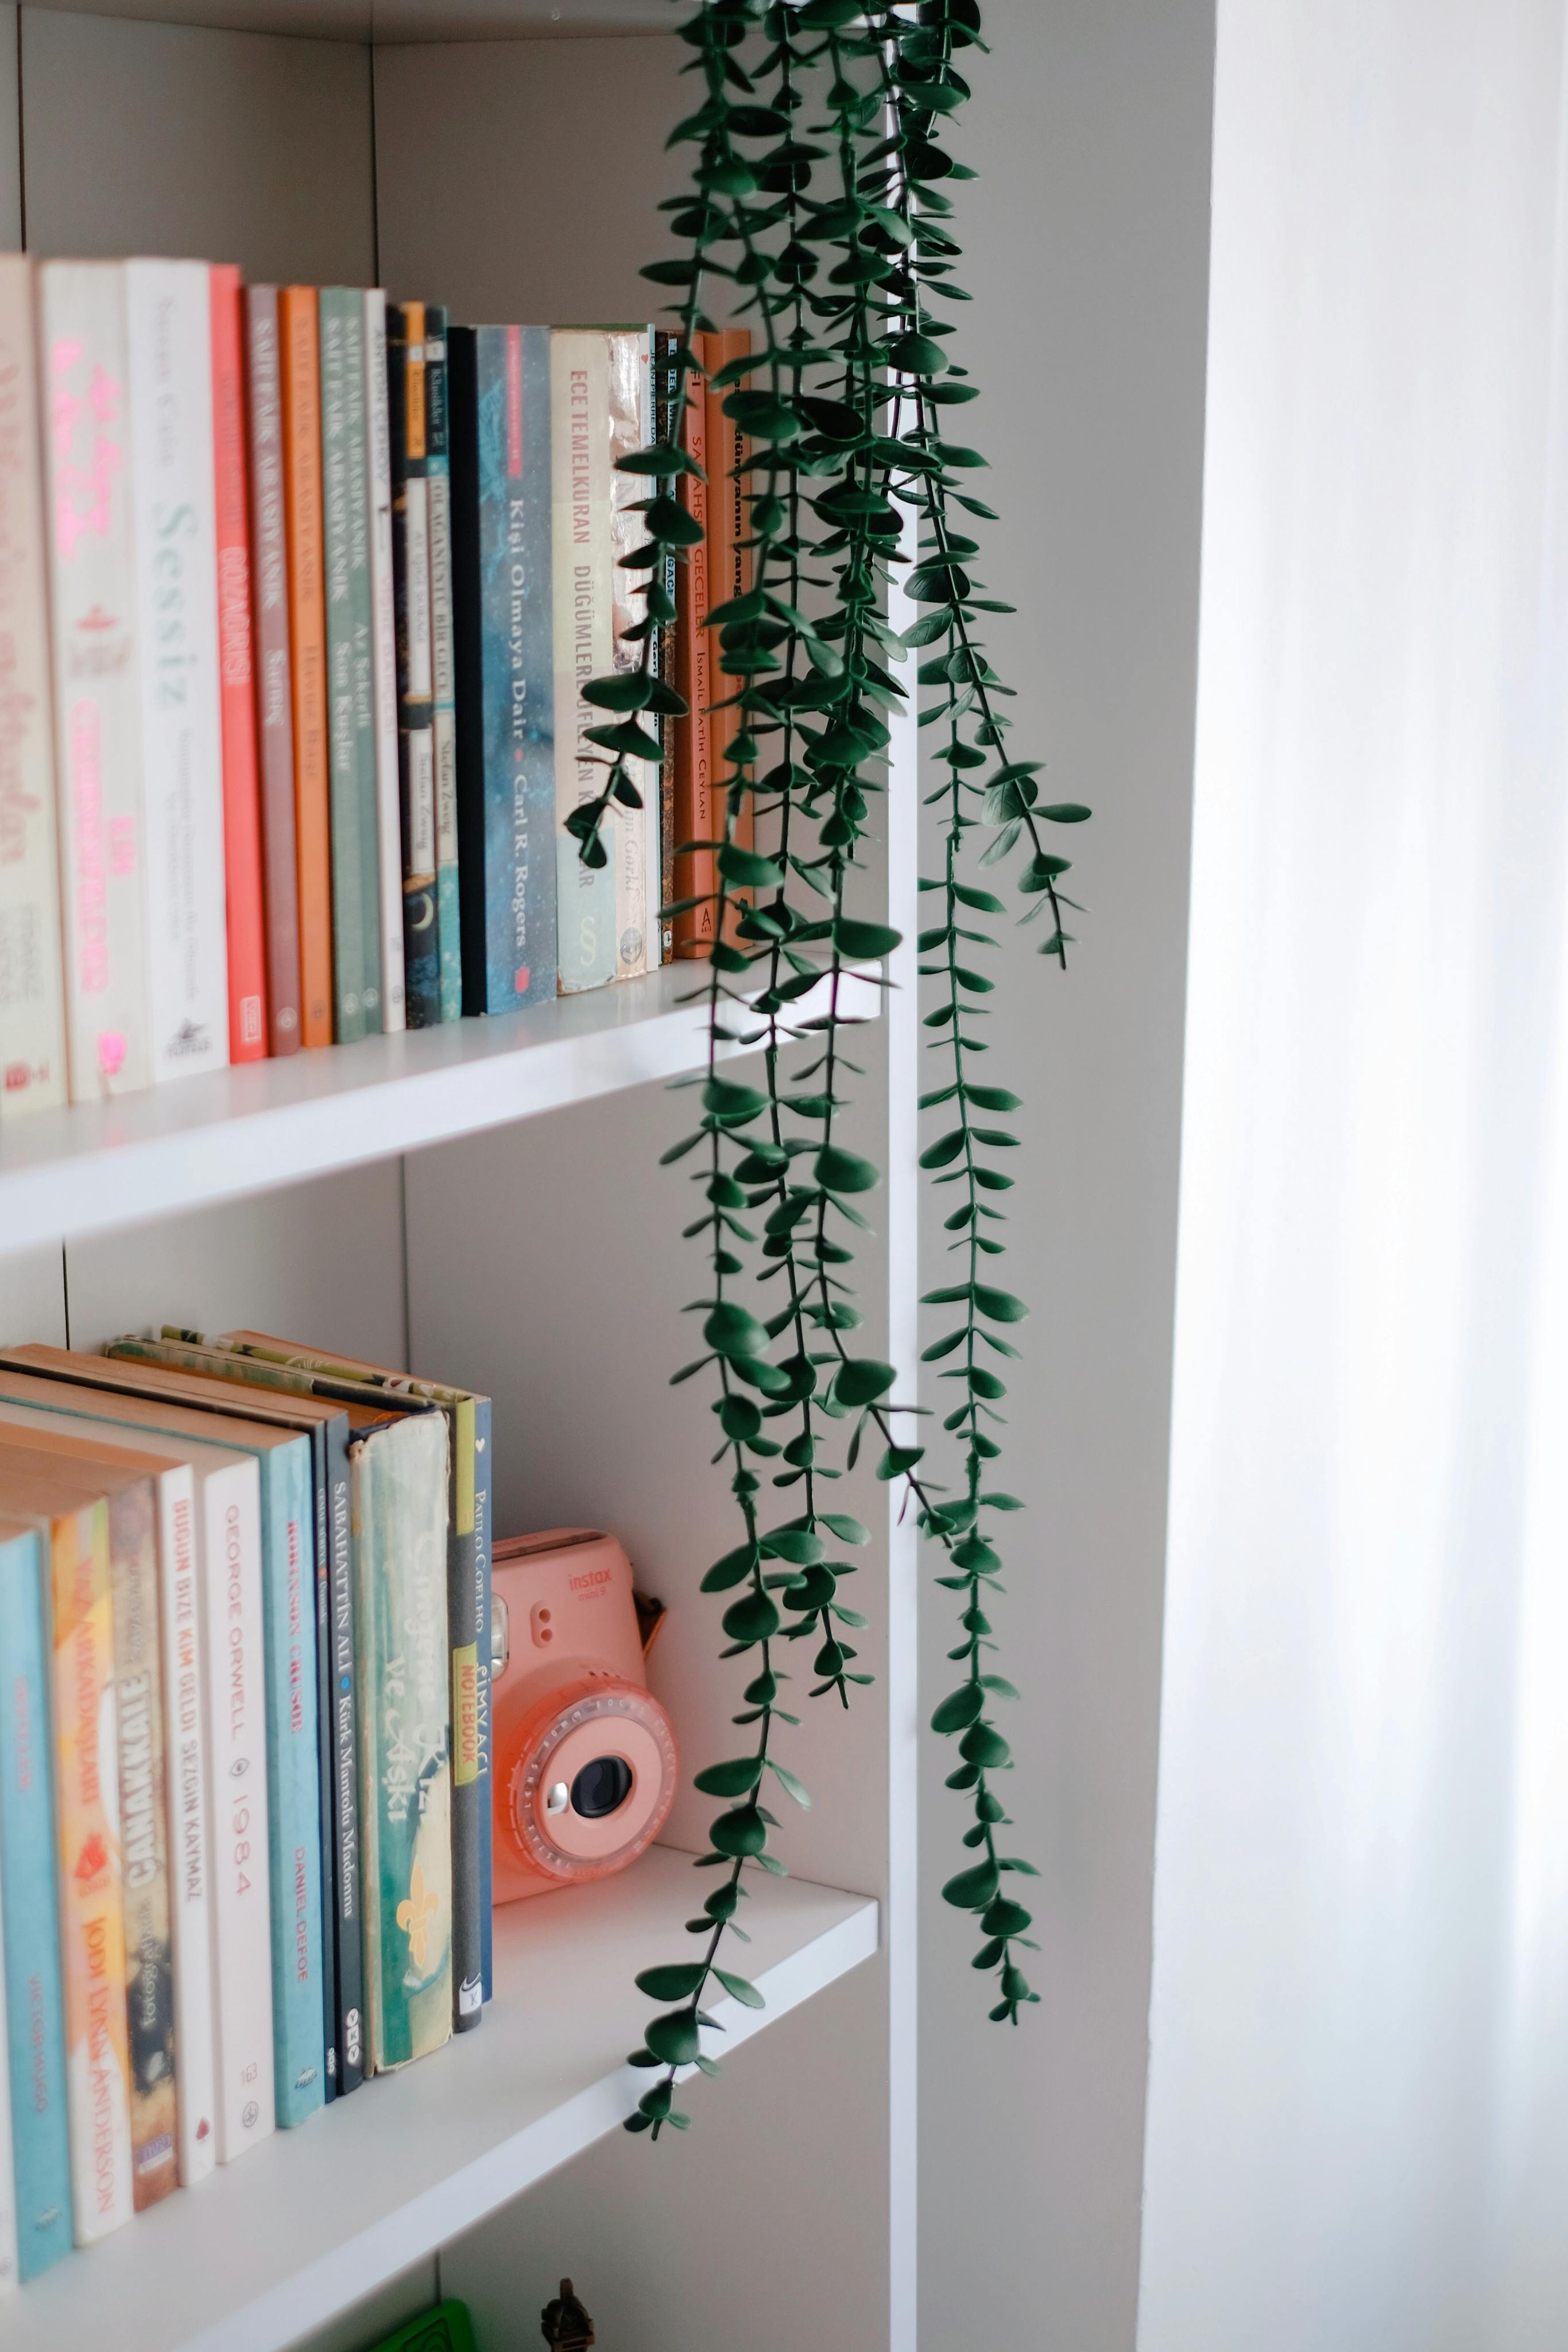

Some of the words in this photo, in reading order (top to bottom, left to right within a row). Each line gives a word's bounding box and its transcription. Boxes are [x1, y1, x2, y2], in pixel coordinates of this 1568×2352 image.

[571, 370, 588, 406] ECE
[572, 412, 590, 544] TEMELKURAN
[508, 499, 525, 554] Kişi
[150, 503, 199, 710] Sessiz
[509, 564, 526, 669] Olmaya
[574, 566, 595, 690] DÜĞÜMLERE
[694, 548, 704, 638] GECELER
[512, 679, 528, 740] Dair
[441, 740, 452, 787] Stefan
[416, 804, 431, 850] Zweig
[438, 792, 452, 835] Zweig
[513, 774, 529, 825] Carl
[514, 833, 528, 857] R.
[624, 840, 638, 892] Gorki
[512, 865, 529, 946] Rogers
[172, 1498, 191, 1572] BUGÜN
[475, 1489, 486, 1549] PAULO
[224, 1505, 243, 1619] GEORGE
[287, 1520, 300, 1636] ROBINSON
[334, 1481, 351, 1633] SABAHATTİN
[568, 1568, 611, 1591] instax
[177, 1577, 193, 1623] BİZE
[474, 1553, 486, 1632] COELHO
[578, 1589, 601, 1601] mini
[601, 1586, 606, 1596] 9
[178, 1627, 195, 1669] KİM
[338, 1635, 353, 1673] ALİ
[386, 1654, 405, 1695] ve
[75, 1621, 99, 1805] ARKADAŞLARI
[180, 1673, 197, 1732] GELDİ
[228, 1627, 245, 1740] ORWELL
[288, 1644, 303, 1733] CRUSOE
[461, 1665, 476, 1764] NOTEBOOK
[338, 1695, 352, 1743] Kürk
[180, 1739, 200, 1813] SEZGİN
[339, 1745, 354, 1825] Mantolu
[382, 1708, 417, 1823] Aşkı
[524, 1763, 538, 1808] LENS
[186, 1817, 203, 1902] KAYMAZ
[232, 1794, 251, 1896] 1984
[341, 1828, 355, 1919] Madonna
[294, 1847, 307, 1917] DANIEL
[82, 1916, 108, 1978] JODI
[295, 1920, 308, 1982] DEFOE
[88, 1986, 110, 2061] LYNN
[33, 2053, 49, 2114] HUGO
[241, 2061, 258, 2086] 163
[91, 2069, 117, 2214] ANDERSON
